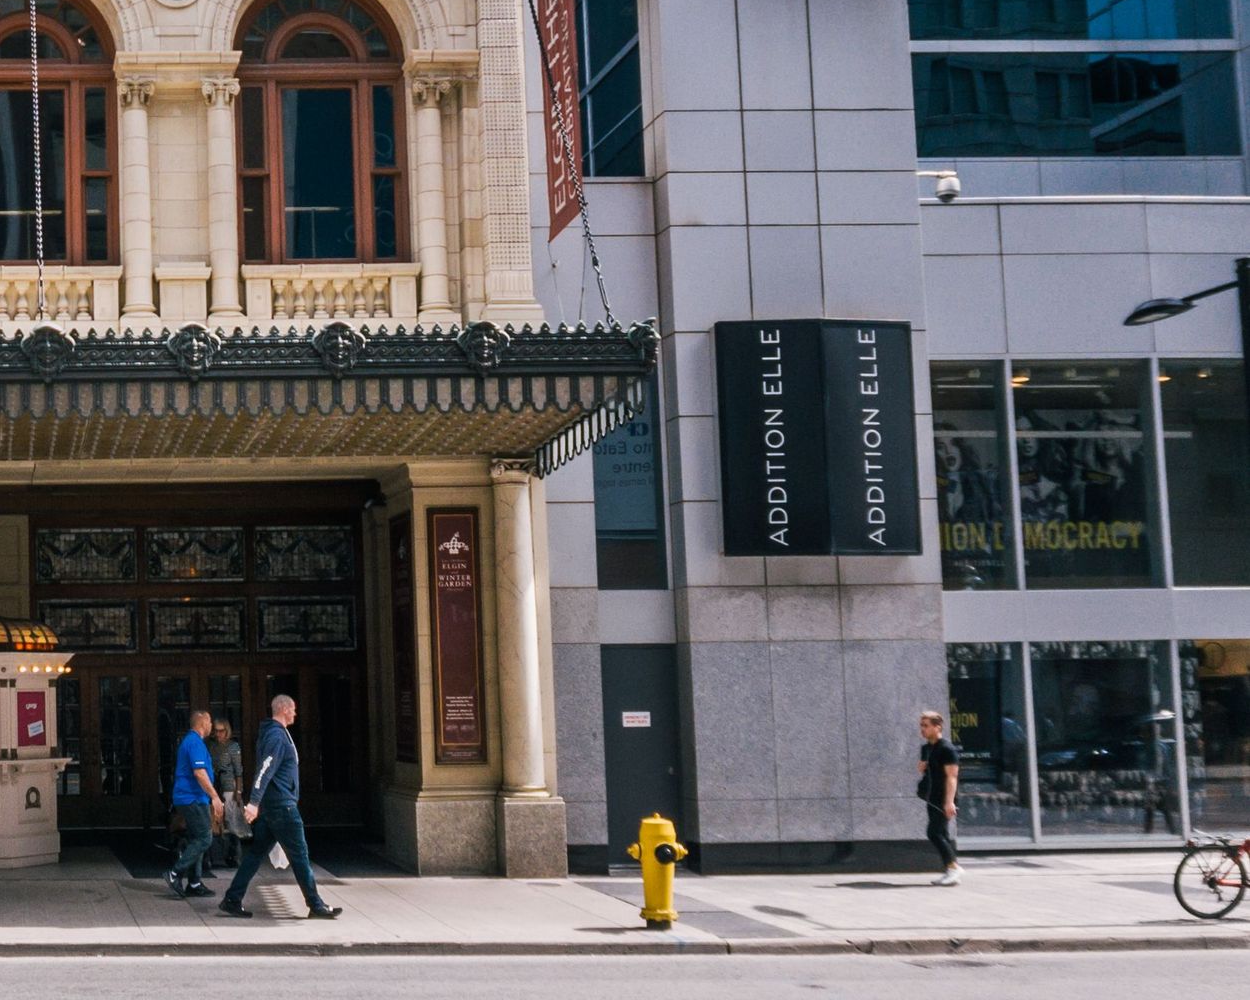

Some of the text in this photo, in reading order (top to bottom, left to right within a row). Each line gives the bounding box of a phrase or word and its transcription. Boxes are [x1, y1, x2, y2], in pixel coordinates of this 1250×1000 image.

[760, 329, 789, 546] ADDITION ELLE
[857, 329, 887, 546] ADDITION ELLE
